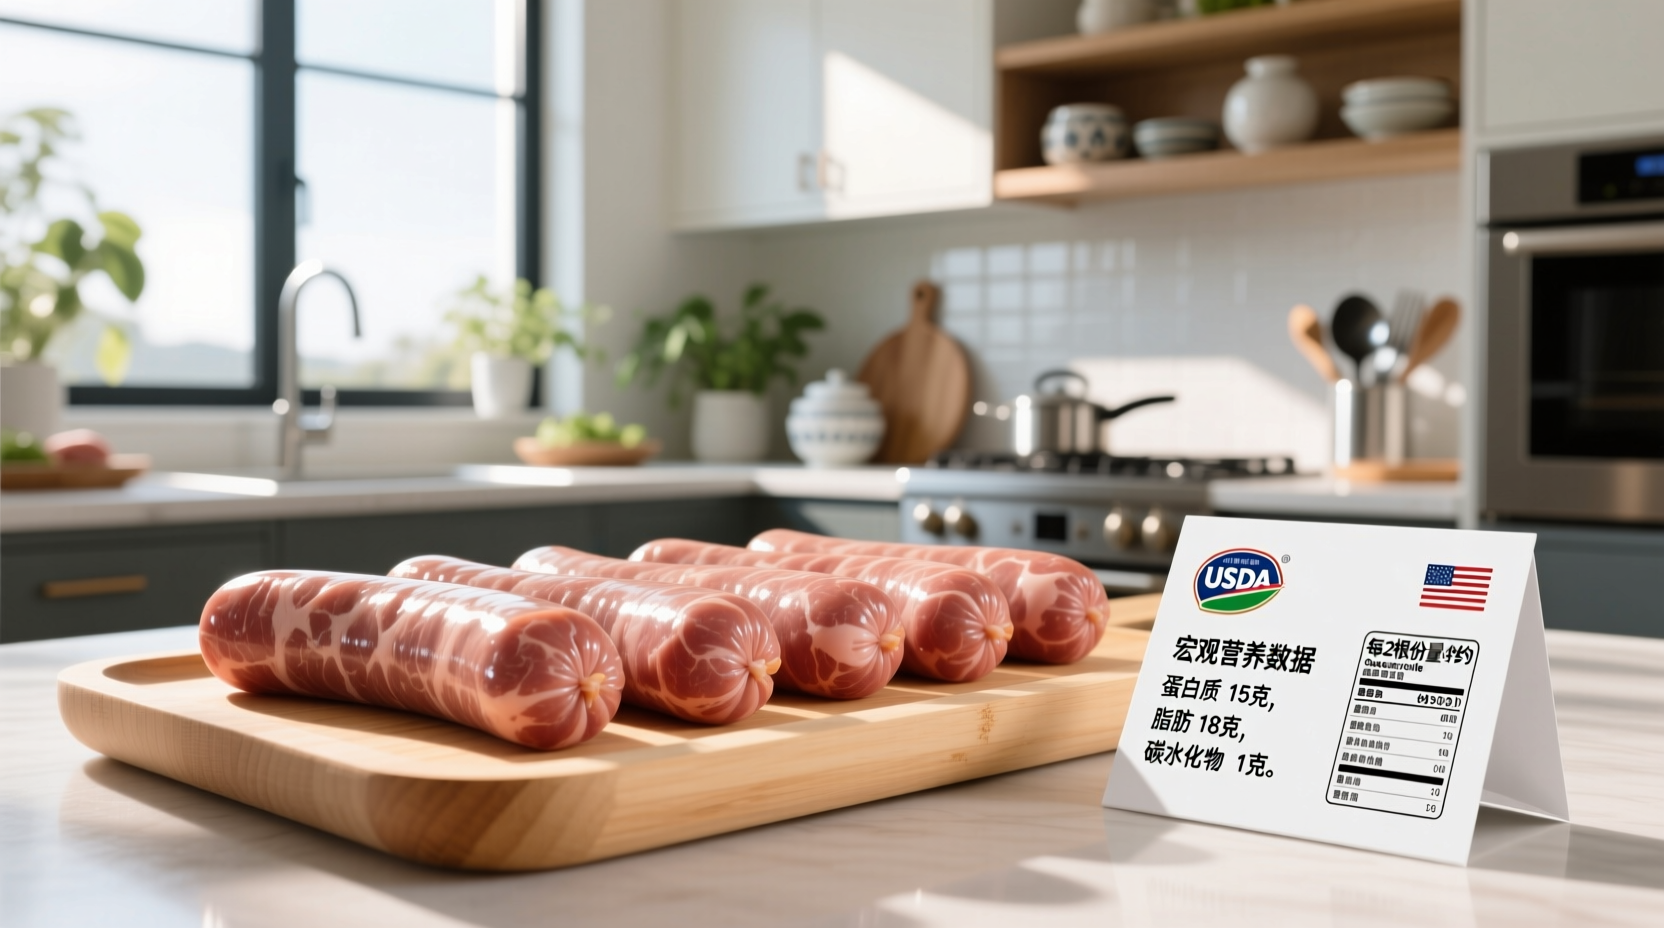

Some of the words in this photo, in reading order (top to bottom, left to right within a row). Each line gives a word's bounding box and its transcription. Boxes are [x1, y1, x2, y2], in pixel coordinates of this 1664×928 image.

[1205, 566, 1270, 590] USDA
[1173, 635, 1317, 674] 宏观营养数据
[1161, 675, 1222, 701] 蛋白质
[1151, 707, 1194, 733] 脂肪
[1144, 740, 1225, 771] 碳水化物
